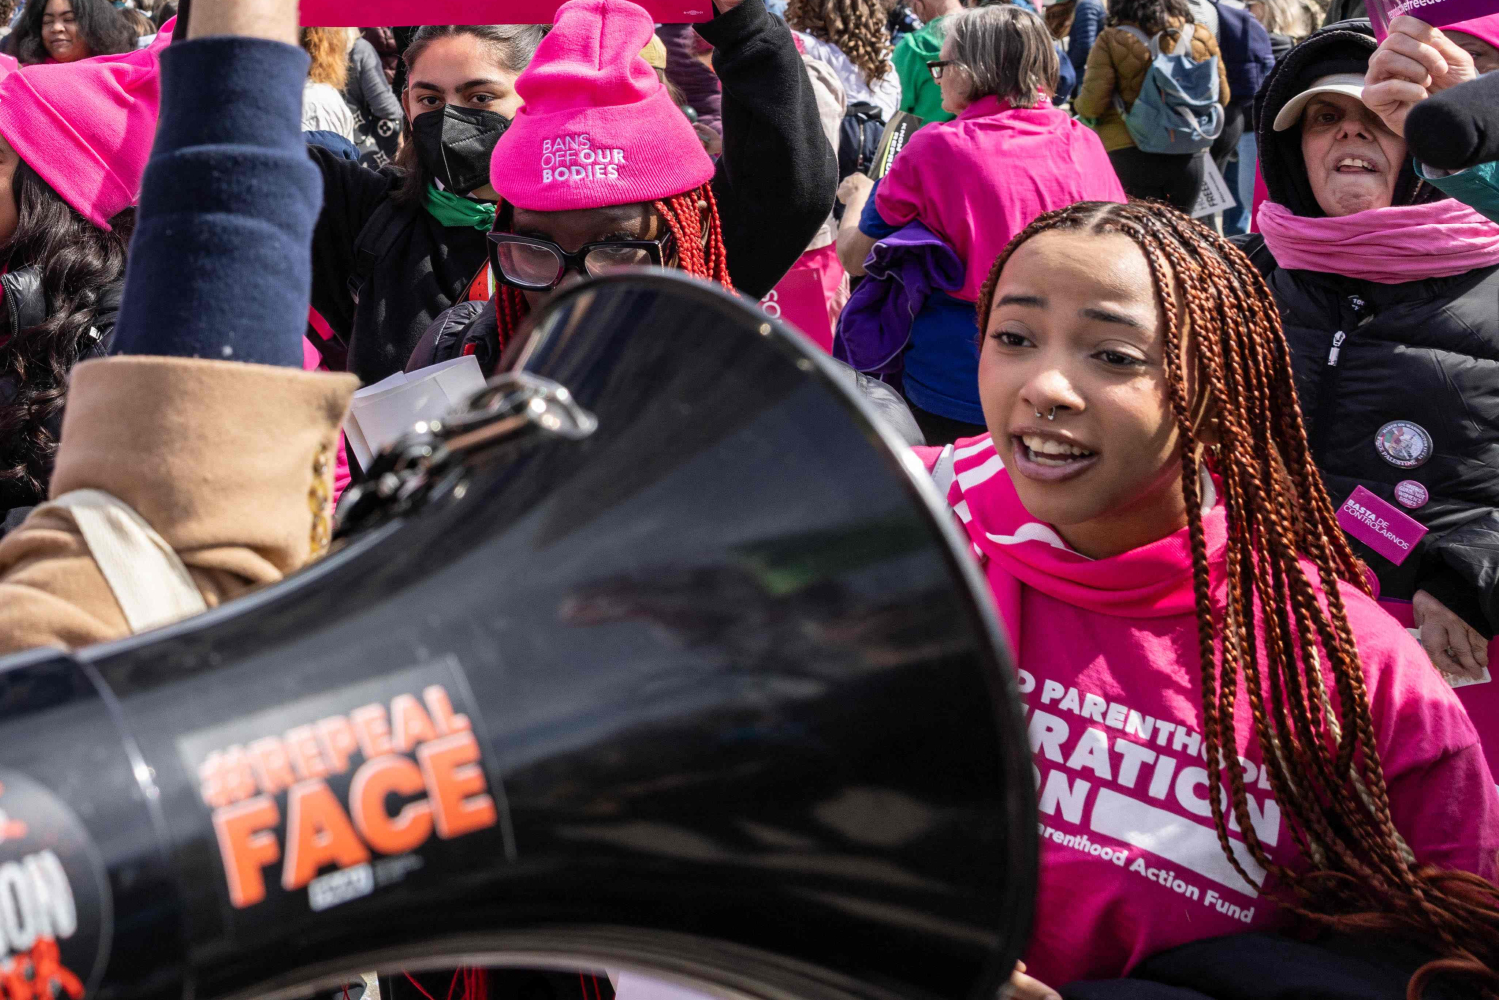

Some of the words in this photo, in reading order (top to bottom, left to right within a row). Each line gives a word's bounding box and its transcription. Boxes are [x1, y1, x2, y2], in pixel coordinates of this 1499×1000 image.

[541, 151, 576, 168] OFF
[579, 149, 626, 164] OUR
[543, 134, 590, 154] BANS
[543, 164, 618, 183] BODIES
[1344, 505, 1409, 550] CONTROLARNOS
[1347, 499, 1376, 520] BASTA
[1377, 518, 1389, 529] DE
[200, 684, 472, 808] #REPEAL
[1024, 706, 1281, 847] RATION
[212, 731, 497, 910] FACE
[1038, 822, 1129, 867] arenthood
[1130, 858, 1200, 901] Action
[1204, 889, 1255, 923] Fund
